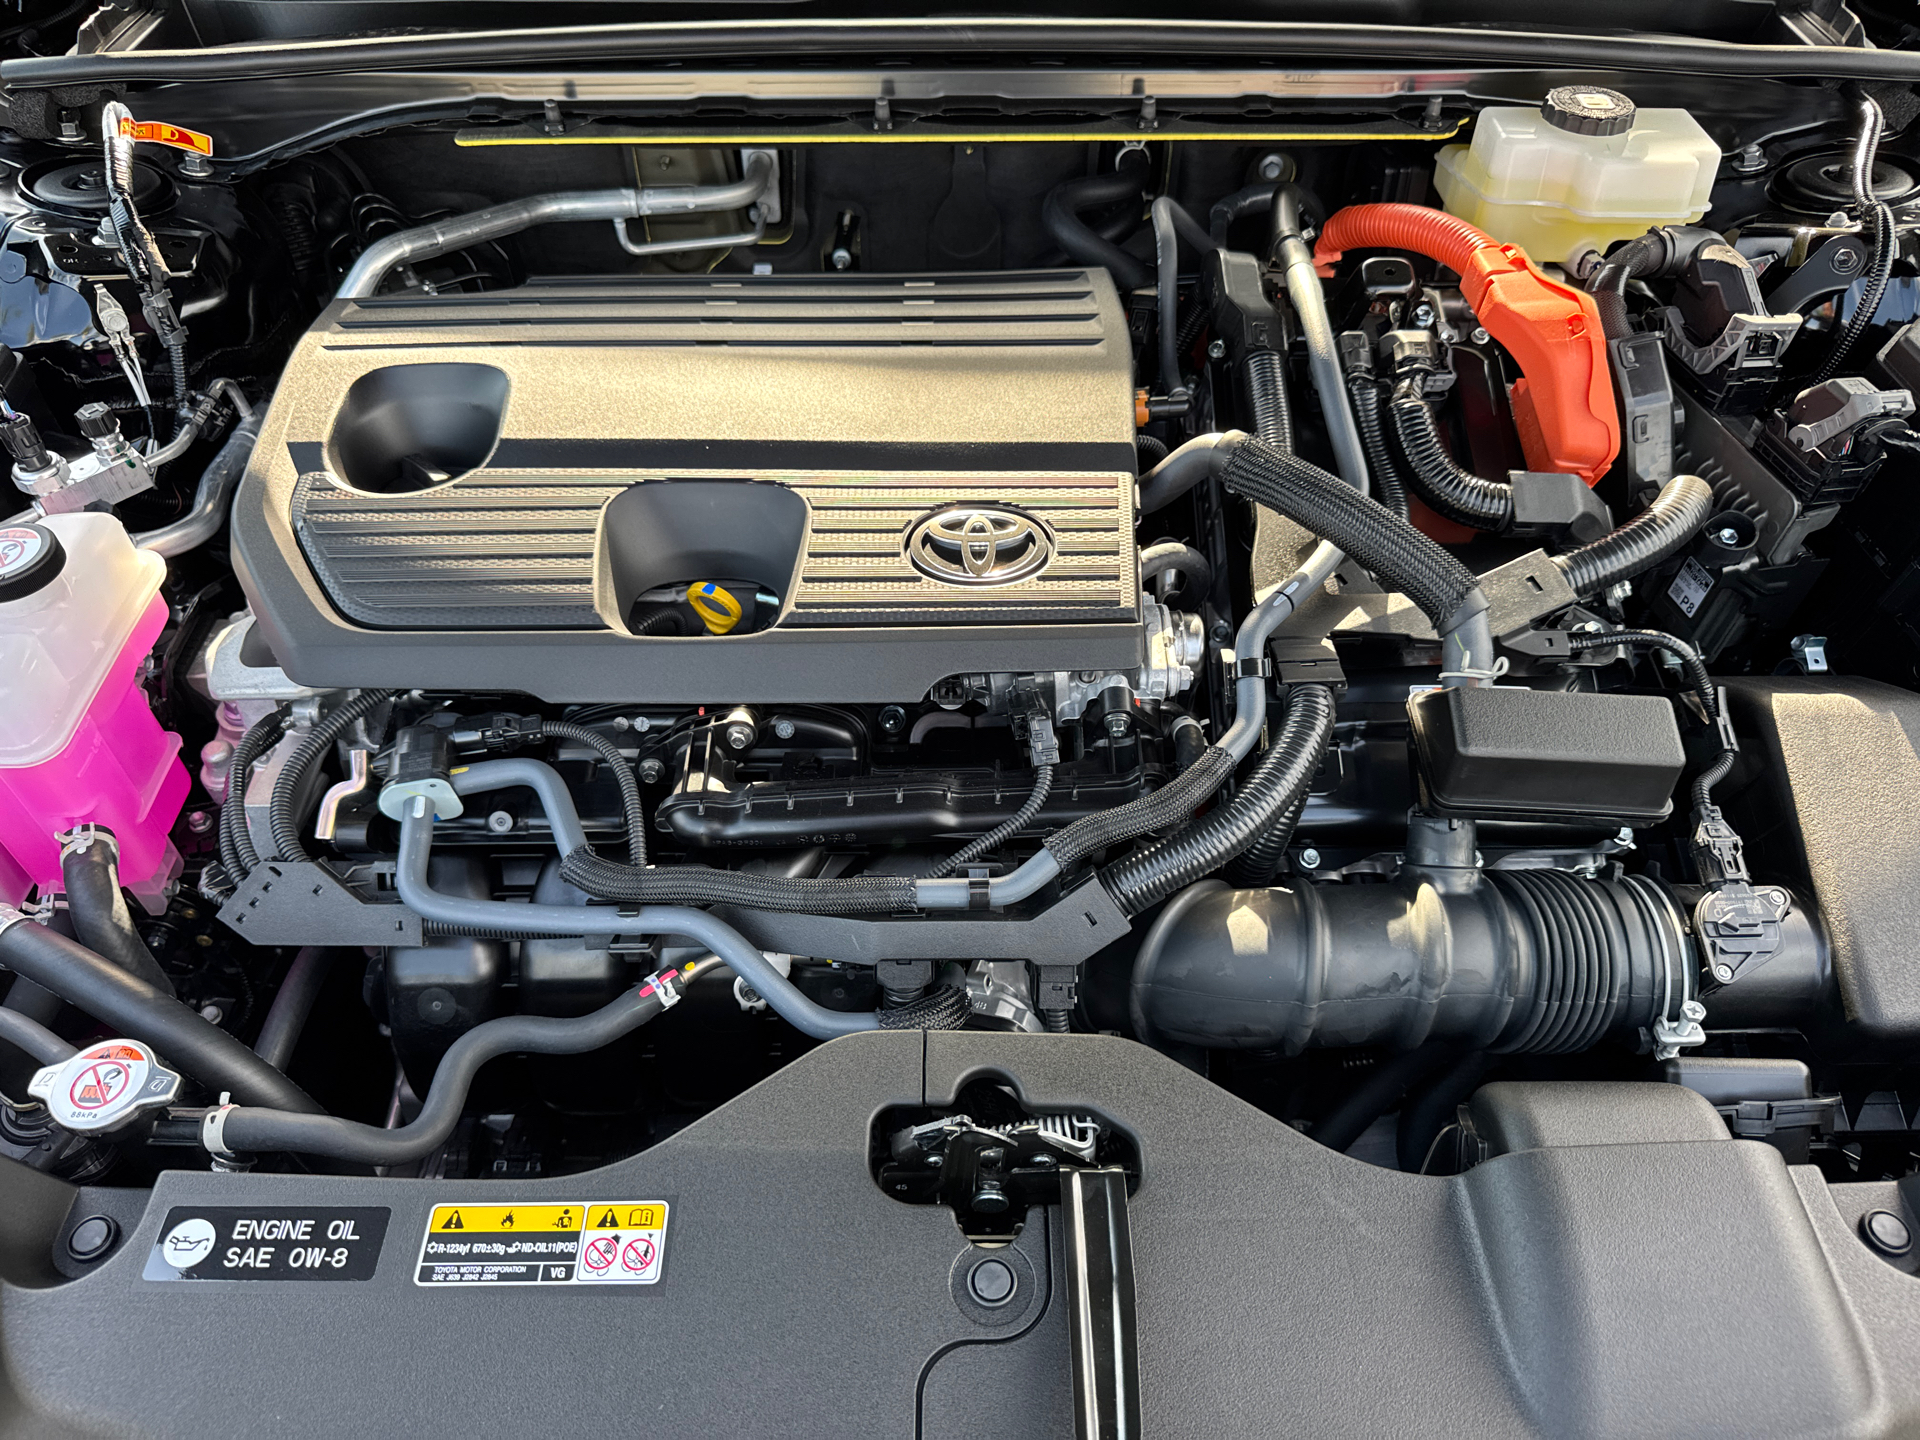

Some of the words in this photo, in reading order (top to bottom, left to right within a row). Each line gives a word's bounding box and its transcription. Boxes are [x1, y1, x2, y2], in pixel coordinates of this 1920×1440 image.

[1680, 595, 1695, 613] P8
[70, 1111, 98, 1119] 88kPa
[232, 1220, 316, 1240] ENGINE
[327, 1220, 360, 1240] OIL
[437, 1243, 471, 1256] R-1234yf
[521, 1241, 578, 1254] ND-OIL11(POE)
[223, 1247, 275, 1268] SAE
[288, 1248, 349, 1268] 0W-8
[434, 1266, 458, 1274] TOYOTA
[550, 1267, 566, 1278] VG
